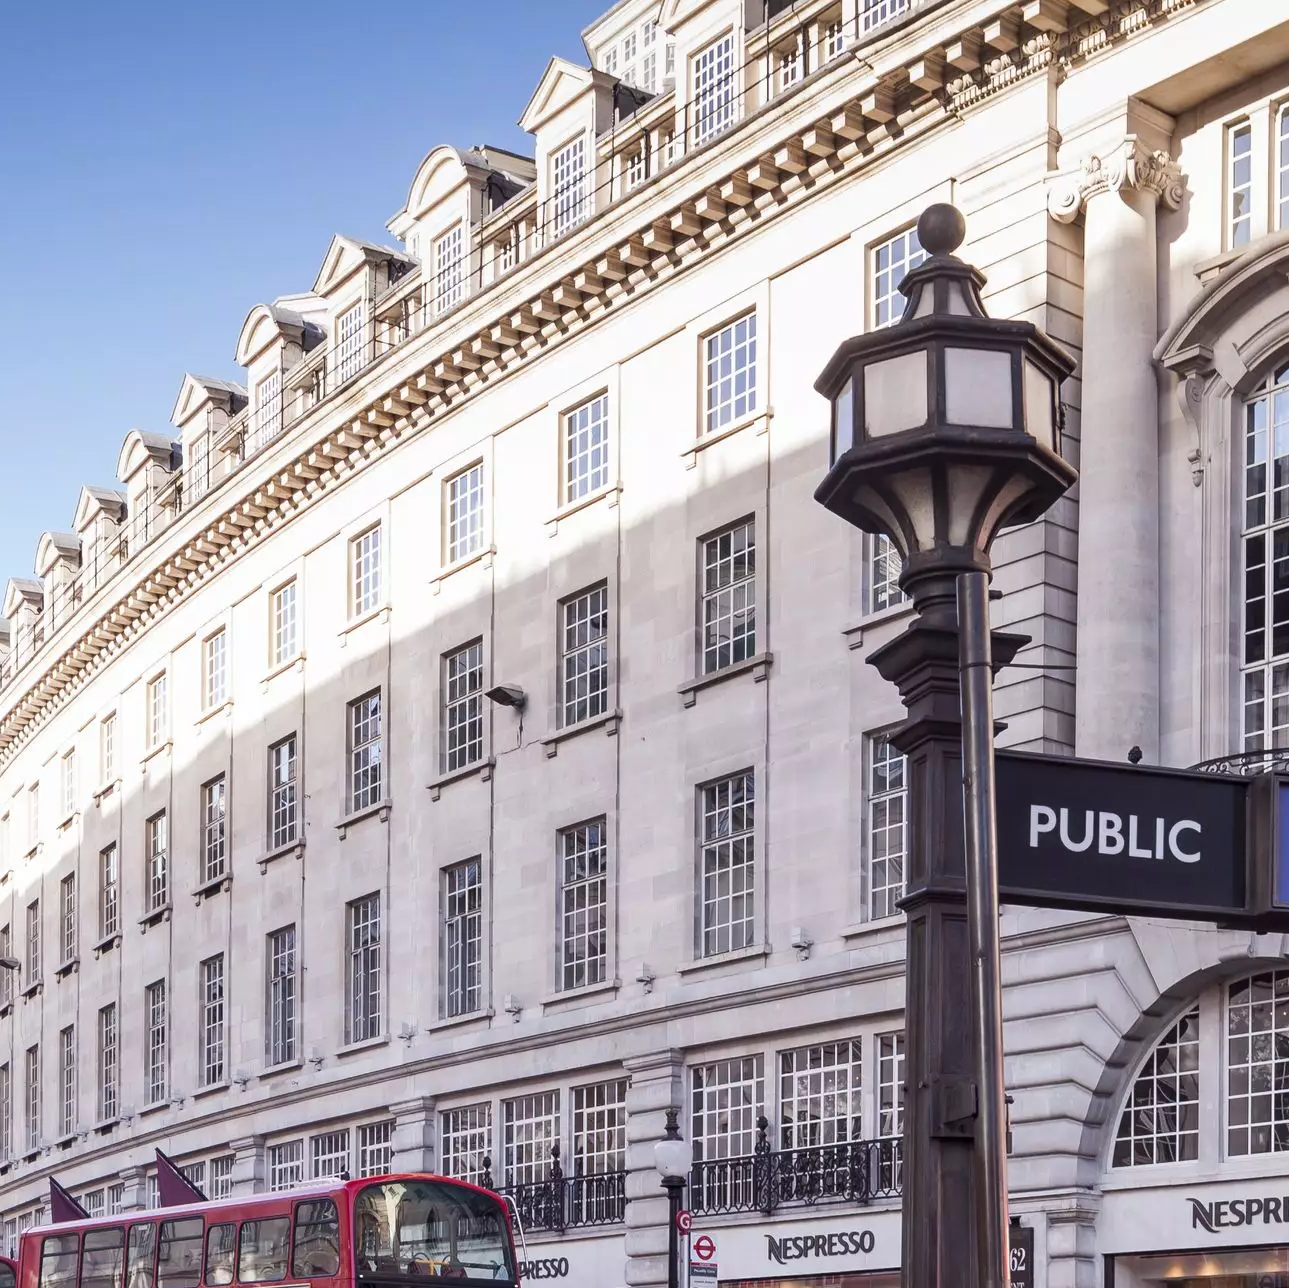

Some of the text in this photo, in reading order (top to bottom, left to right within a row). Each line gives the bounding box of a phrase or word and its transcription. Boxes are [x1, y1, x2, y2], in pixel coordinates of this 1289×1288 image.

[1029, 803, 1202, 864] PUBLIC
[680, 1213, 690, 1229] G
[764, 1230, 875, 1265] NESPRESSO
